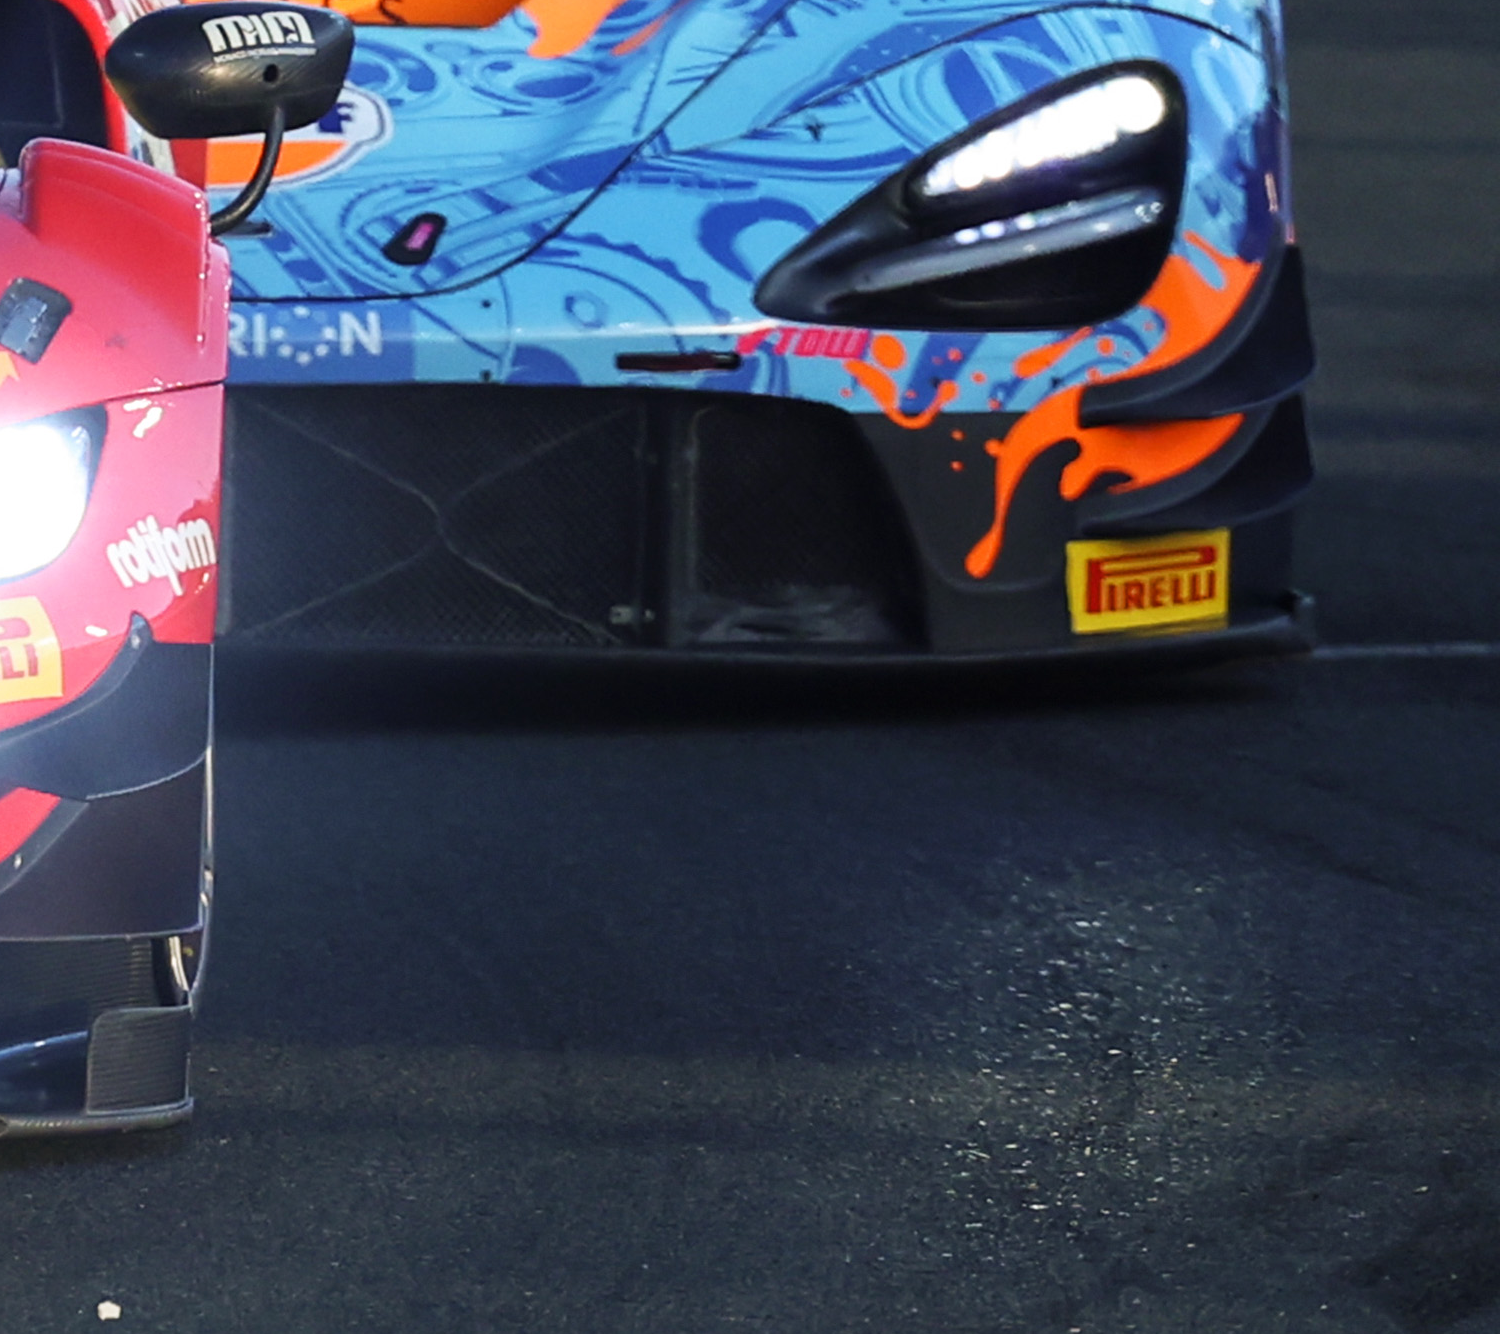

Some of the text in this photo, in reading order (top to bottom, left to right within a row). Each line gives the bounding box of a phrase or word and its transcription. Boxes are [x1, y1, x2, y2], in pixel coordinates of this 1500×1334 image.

[228, 305, 383, 366] RION
[106, 516, 217, 596] rotiform
[1085, 545, 1217, 614] PIRELLI
